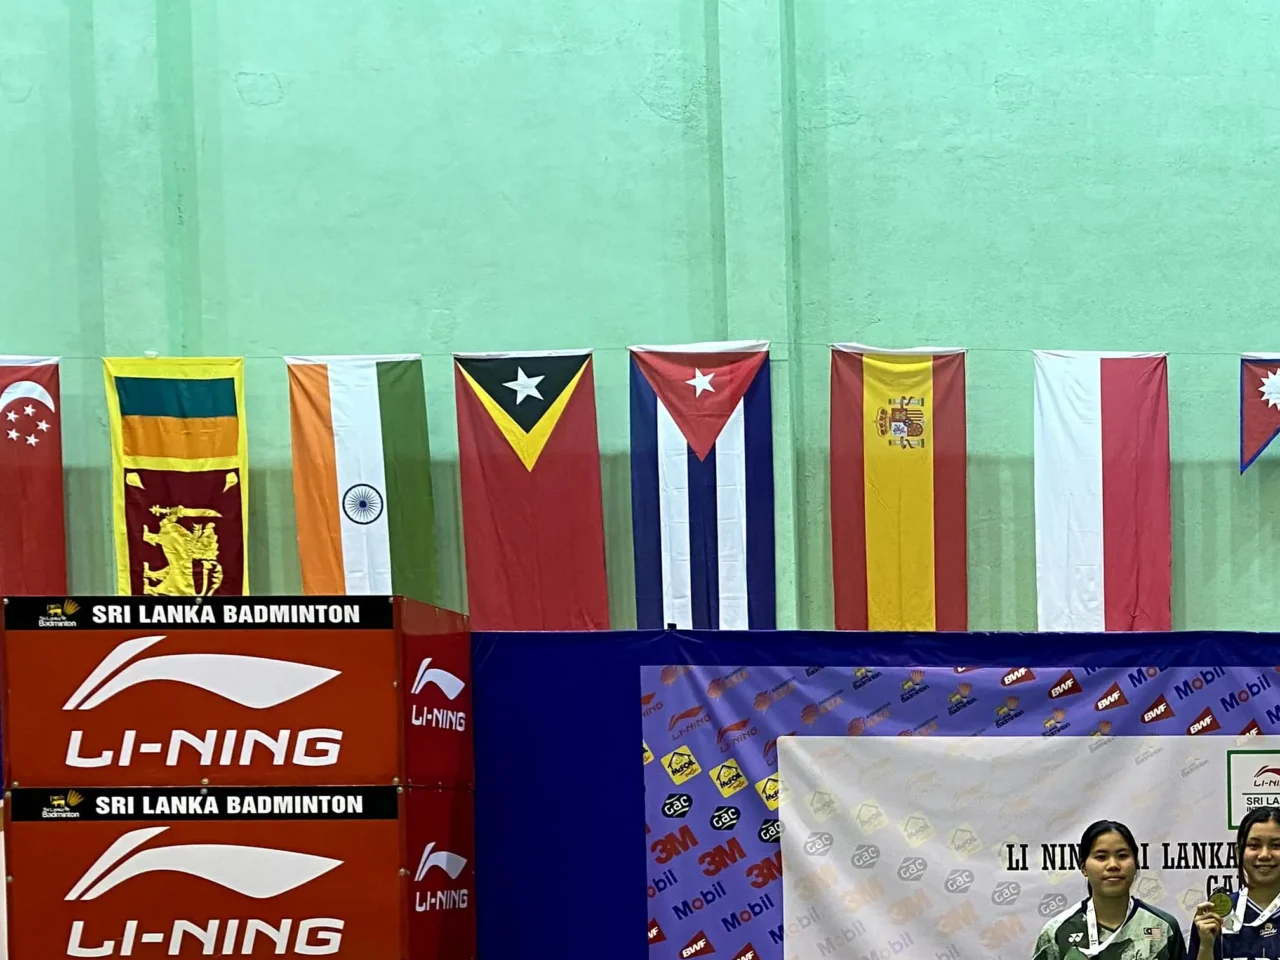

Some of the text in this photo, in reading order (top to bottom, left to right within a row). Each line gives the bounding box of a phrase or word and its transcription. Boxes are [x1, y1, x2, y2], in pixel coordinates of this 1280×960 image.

[92, 604, 360, 624] SRI LANKA BADMINTON
[1003, 667, 1027, 685] BWF
[1051, 679, 1074, 697] BWF
[1097, 690, 1121, 709] BWF
[1220, 674, 1271, 712] Mobil
[412, 705, 466, 732] LI-NING
[1144, 703, 1167, 722] BWF
[1189, 715, 1213, 734] BWF
[64, 728, 343, 768] LI-NING
[96, 795, 363, 815] SRI LANKA BADMINTON
[1246, 797, 1263, 805] SRI
[651, 824, 699, 864] 3M
[698, 837, 747, 876] 3M
[1006, 844, 1028, 870] LI
[1041, 844, 1082, 870] NIN
[1162, 842, 1239, 869] LANKA
[415, 889, 468, 912] LI-NING
[672, 881, 727, 921] Mobil
[721, 893, 775, 933] Mobil
[66, 917, 345, 958] LI-NING
[682, 938, 706, 958] BWF
